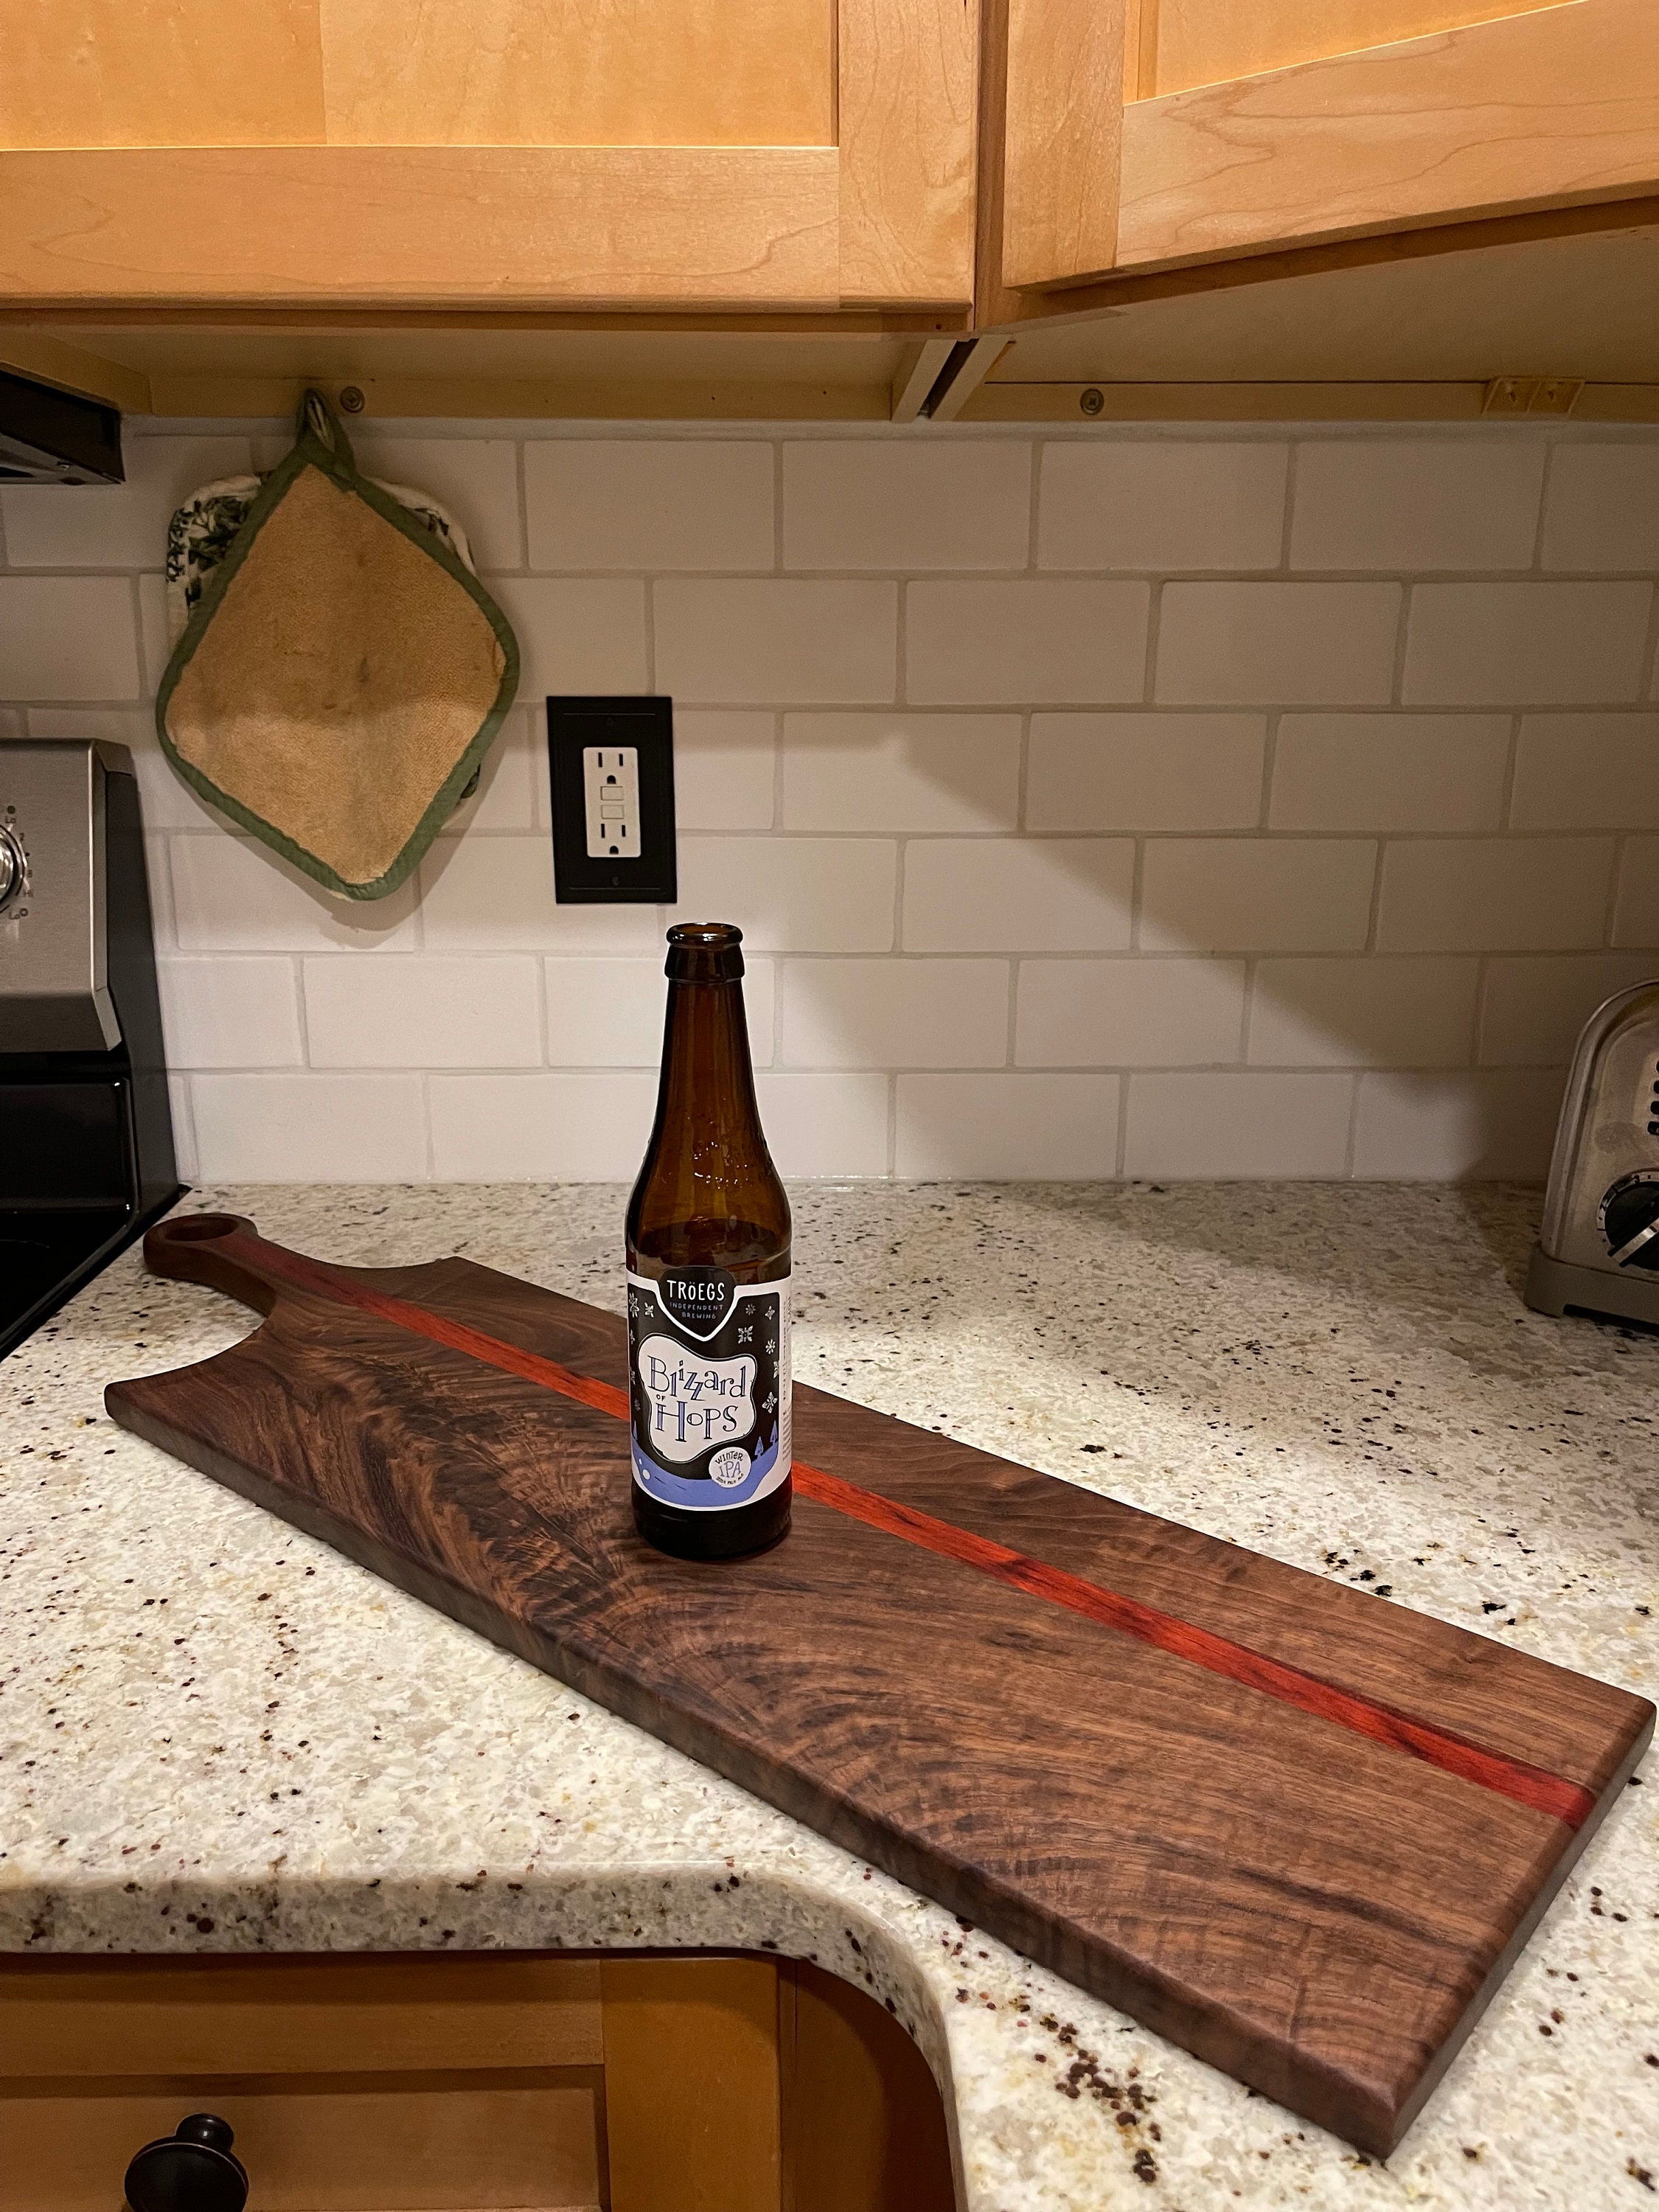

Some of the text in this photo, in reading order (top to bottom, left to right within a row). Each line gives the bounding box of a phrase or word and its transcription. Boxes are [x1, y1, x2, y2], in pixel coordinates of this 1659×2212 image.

[669, 1301, 723, 1311] INDEPENDENT
[681, 1312, 716, 1320] BREWING
[647, 1355, 746, 1401] Blizzard
[719, 1461, 742, 1478] IPA
